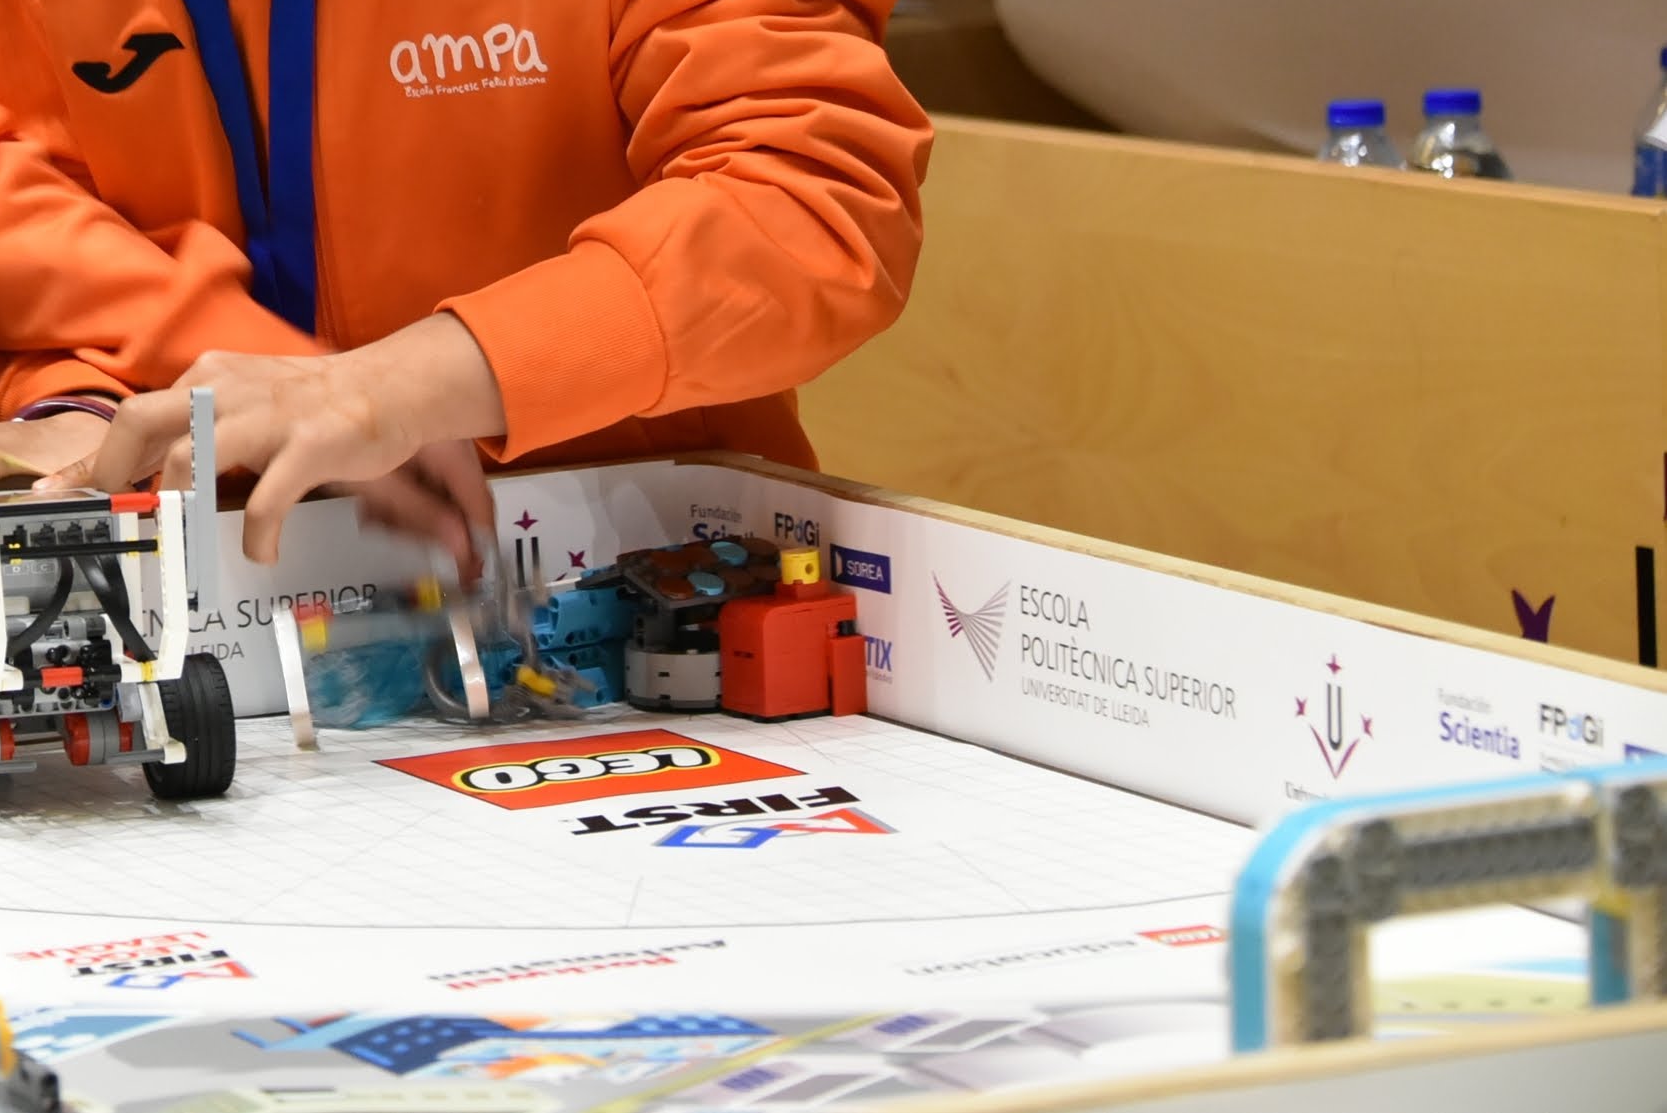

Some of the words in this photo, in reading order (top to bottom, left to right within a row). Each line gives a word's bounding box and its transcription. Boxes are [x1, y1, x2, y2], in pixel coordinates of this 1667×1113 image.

[774, 512, 821, 548] FPdGi
[846, 558, 884, 582] SOREA
[1020, 584, 1090, 632] ESCOLA
[1021, 633, 1140, 693] POLITÈCNICA
[1144, 665, 1237, 719] SUPERIOR
[1021, 676, 1091, 713] UNIVERSITAT
[1094, 695, 1109, 717] DE
[1112, 699, 1151, 729] LLEIDA
[1438, 710, 1521, 760] Scientia
[466, 746, 709, 791] LEGO
[569, 786, 862, 835] FIRST
